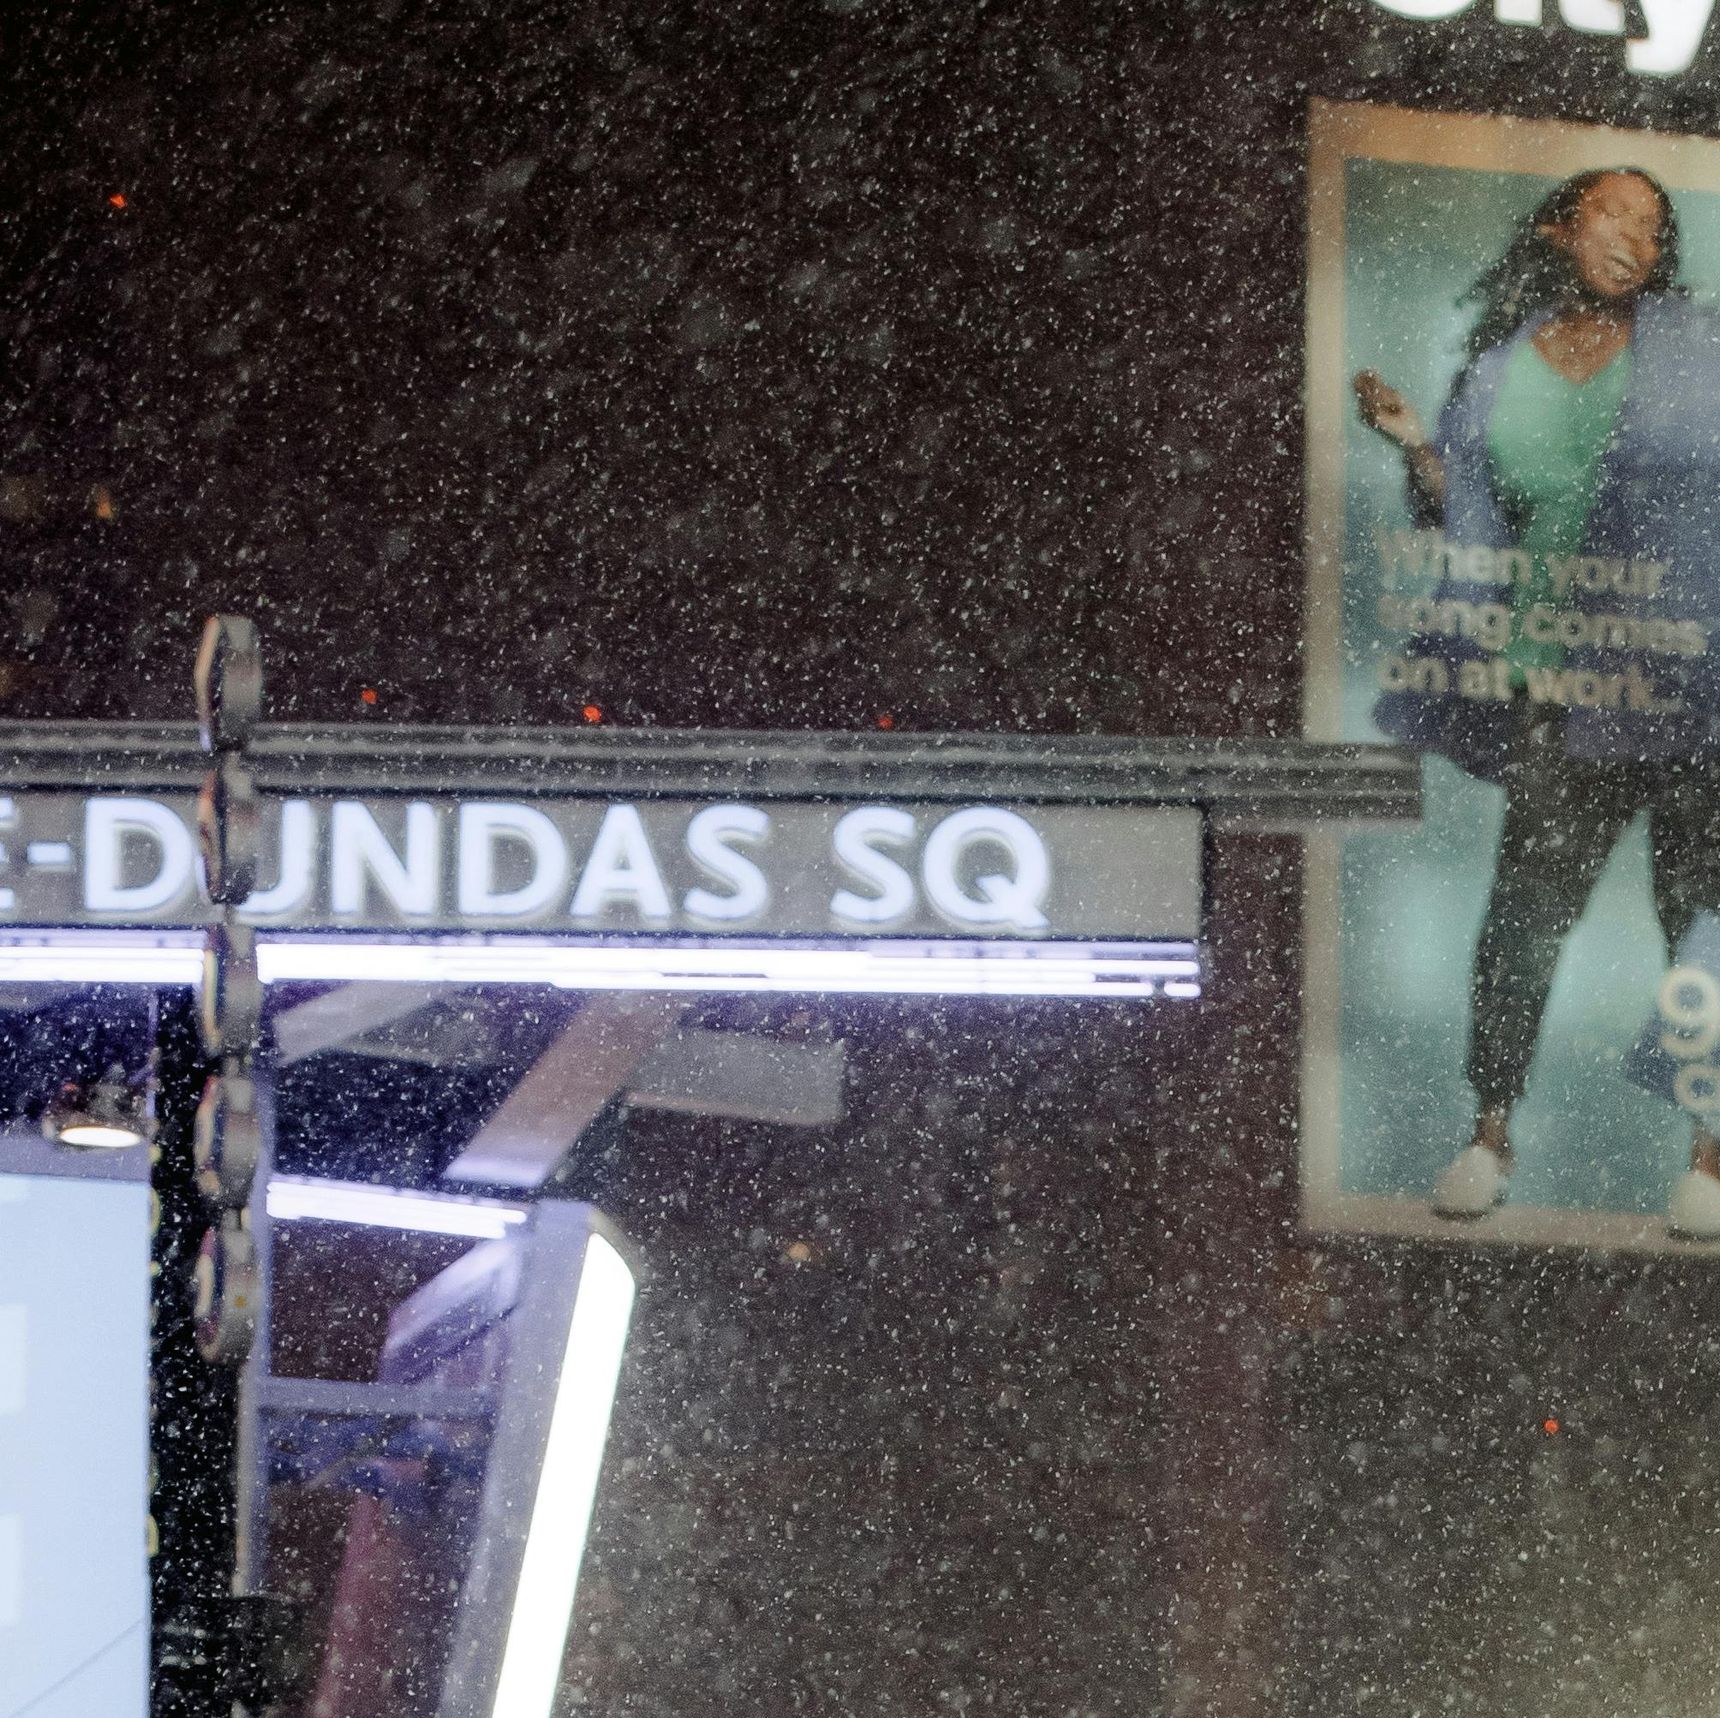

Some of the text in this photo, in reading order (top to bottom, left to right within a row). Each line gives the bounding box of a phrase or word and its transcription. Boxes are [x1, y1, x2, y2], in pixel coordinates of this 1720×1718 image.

[1544, 555, 1671, 598] your
[1375, 593, 1709, 657] song comes
[1376, 656, 1449, 694] on
[1458, 656, 1513, 701] at
[0, 797, 1053, 935] -DUNDAS SQ
